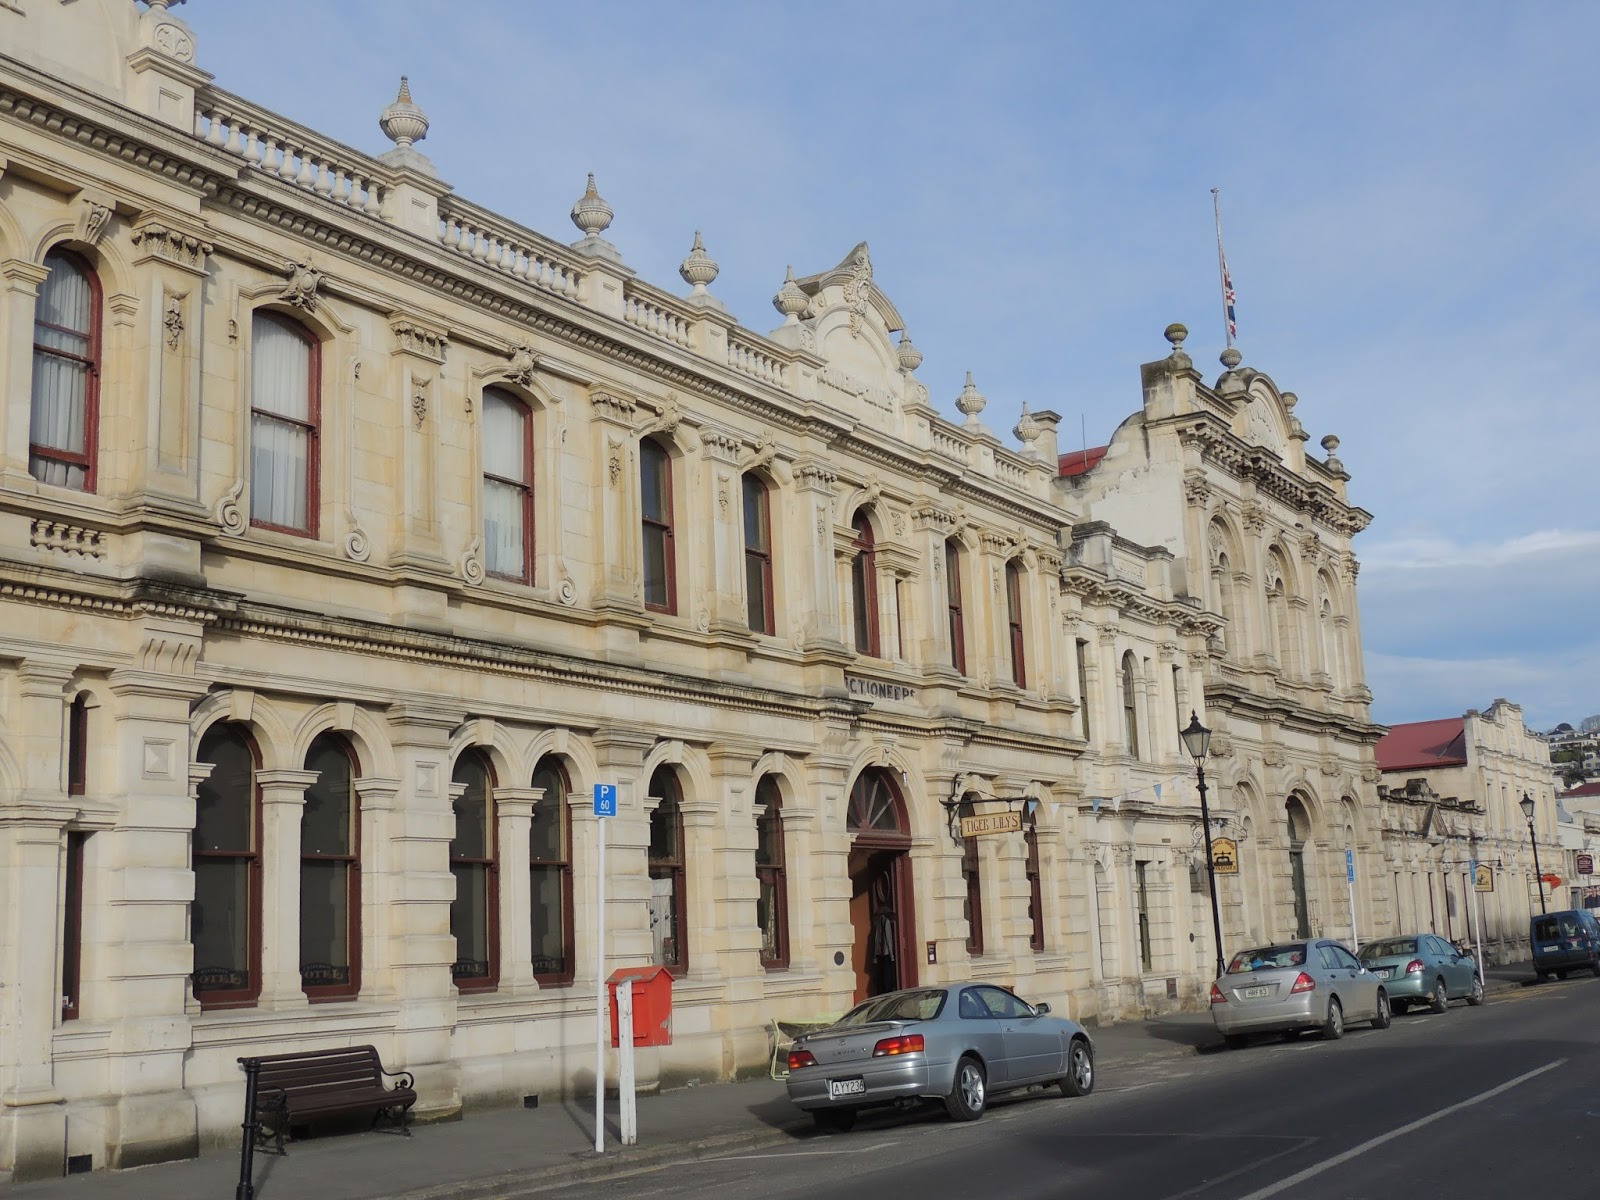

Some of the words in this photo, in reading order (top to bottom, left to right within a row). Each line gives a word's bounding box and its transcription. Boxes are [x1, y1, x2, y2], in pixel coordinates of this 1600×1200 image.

[601, 785, 609, 799] P
[600, 800, 610, 810] 60
[965, 818, 990, 833] TIGER
[199, 973, 242, 985] OTEL
[304, 969, 344, 980] OTEL
[834, 1080, 864, 1094] AYY236
